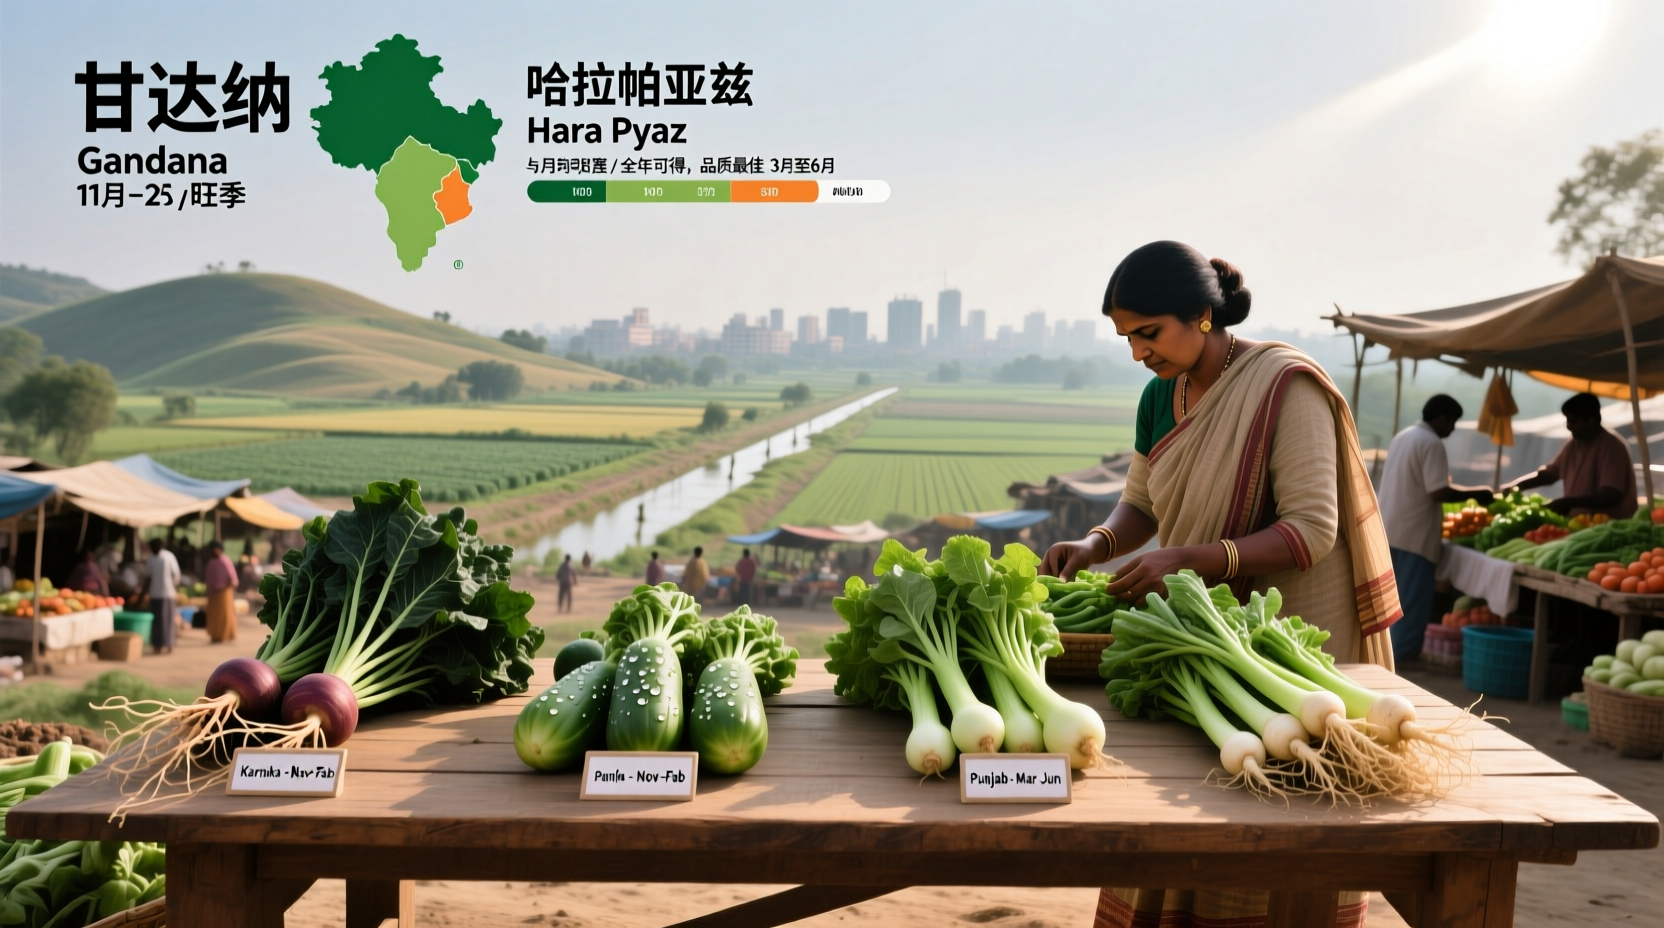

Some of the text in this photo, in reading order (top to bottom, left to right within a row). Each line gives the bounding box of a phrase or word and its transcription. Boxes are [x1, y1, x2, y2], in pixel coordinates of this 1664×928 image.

[970, 771, 1008, 788] Punjab
[1016, 772, 1037, 785] Mar
[1039, 772, 1062, 785] Jun
